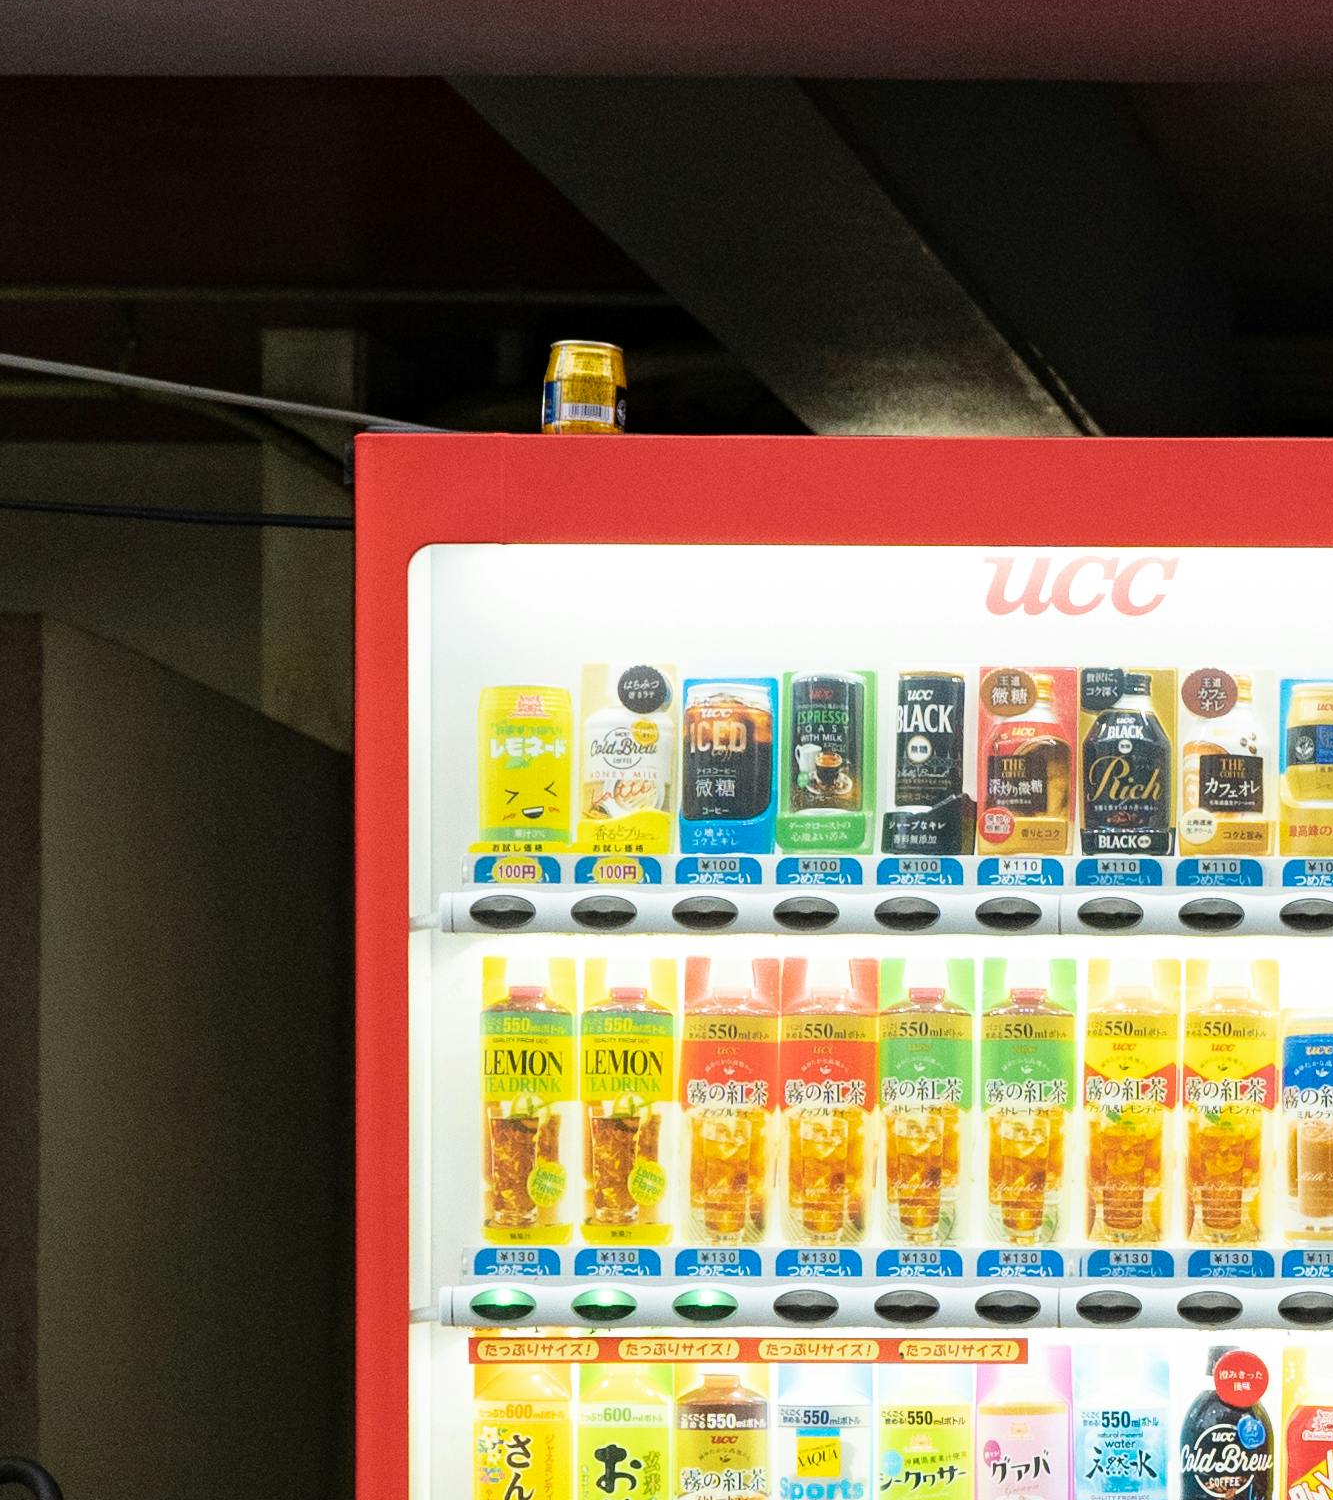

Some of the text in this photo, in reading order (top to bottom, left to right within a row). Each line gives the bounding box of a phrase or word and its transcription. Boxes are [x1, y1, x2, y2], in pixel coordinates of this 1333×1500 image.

[984, 555, 1180, 617] ucc
[908, 690, 933, 701] ucc
[991, 688, 1027, 705] 微糖
[1198, 688, 1227, 700] カフェ
[1201, 700, 1225, 711] オレ
[896, 704, 952, 734] BLACK
[1108, 725, 1143, 739] BLACK
[489, 736, 567, 760] レモネード
[1087, 755, 1162, 802] Rich
[695, 778, 736, 798] 微糖
[1204, 778, 1260, 799] カフェオレ
[702, 806, 729, 816] コーヒー
[492, 843, 543, 853] お試し価格
[498, 864, 536, 879] 100円
[599, 864, 637, 879] 100円
[701, 859, 737, 871] ¥100
[802, 859, 838, 871] ¥100
[902, 860, 939, 872] ¥100
[1003, 860, 1038, 872] ¥110
[1102, 861, 1137, 872] ¥110
[484, 1050, 563, 1076] LEMON
[585, 1050, 664, 1076] LEMON
[687, 1081, 768, 1106] 霧の紅茶
[784, 1081, 865, 1106] 霧の紅茶
[500, 1251, 535, 1263] ¥130
[701, 1251, 737, 1263] ¥130
[902, 1253, 937, 1264] ¥130
[1105, 1438, 1136, 1450] water
[1085, 1451, 1158, 1480] 天然水
[1180, 1447, 1273, 1474] Cold Brew
[1208, 1476, 1241, 1487] COFFEE
